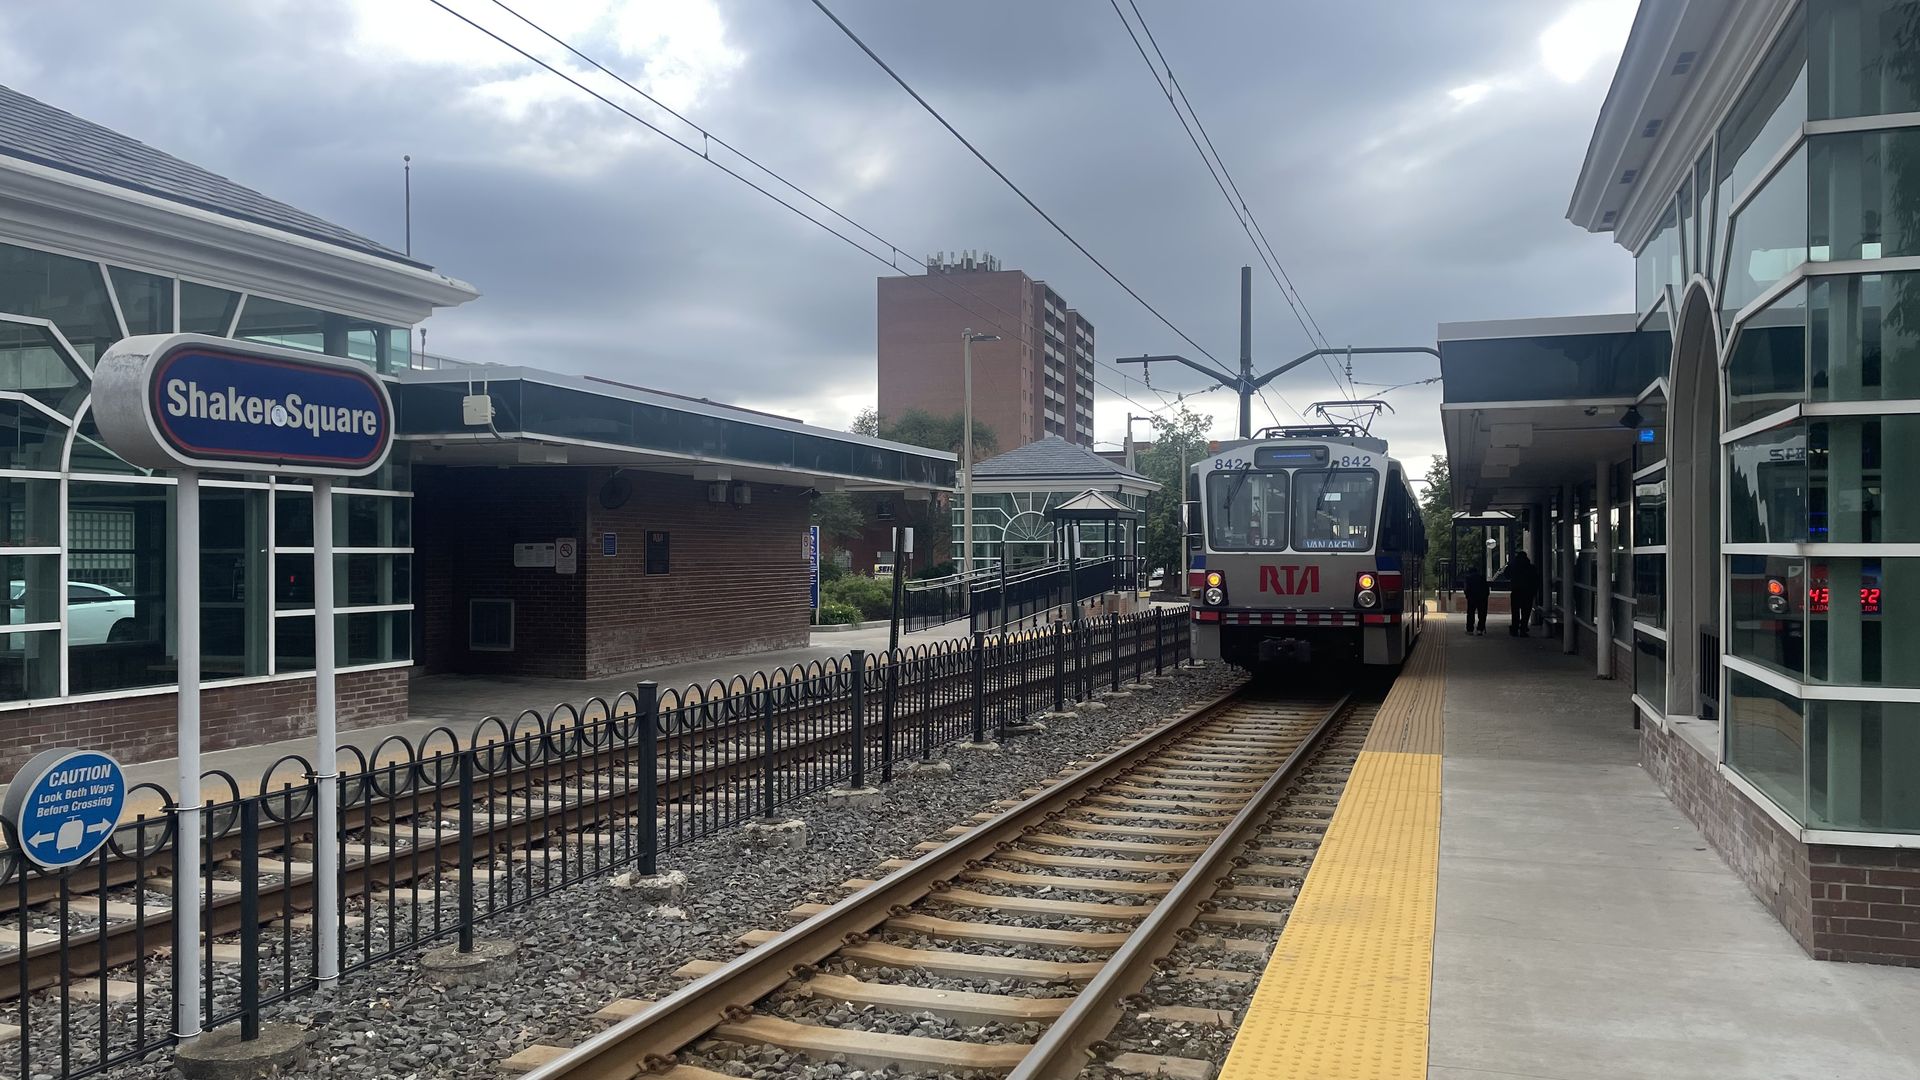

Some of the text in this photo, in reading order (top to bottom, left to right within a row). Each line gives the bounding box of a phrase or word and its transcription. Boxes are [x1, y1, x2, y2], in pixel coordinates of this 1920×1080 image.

[167, 379, 377, 437] Shaker Square
[1214, 458, 1244, 470] 842
[1341, 456, 1371, 468] 842
[1260, 565, 1320, 595] RTA
[49, 764, 111, 787] CAUTION
[39, 784, 114, 804] Look Both Ways
[37, 797, 112, 817] Before Crossing
